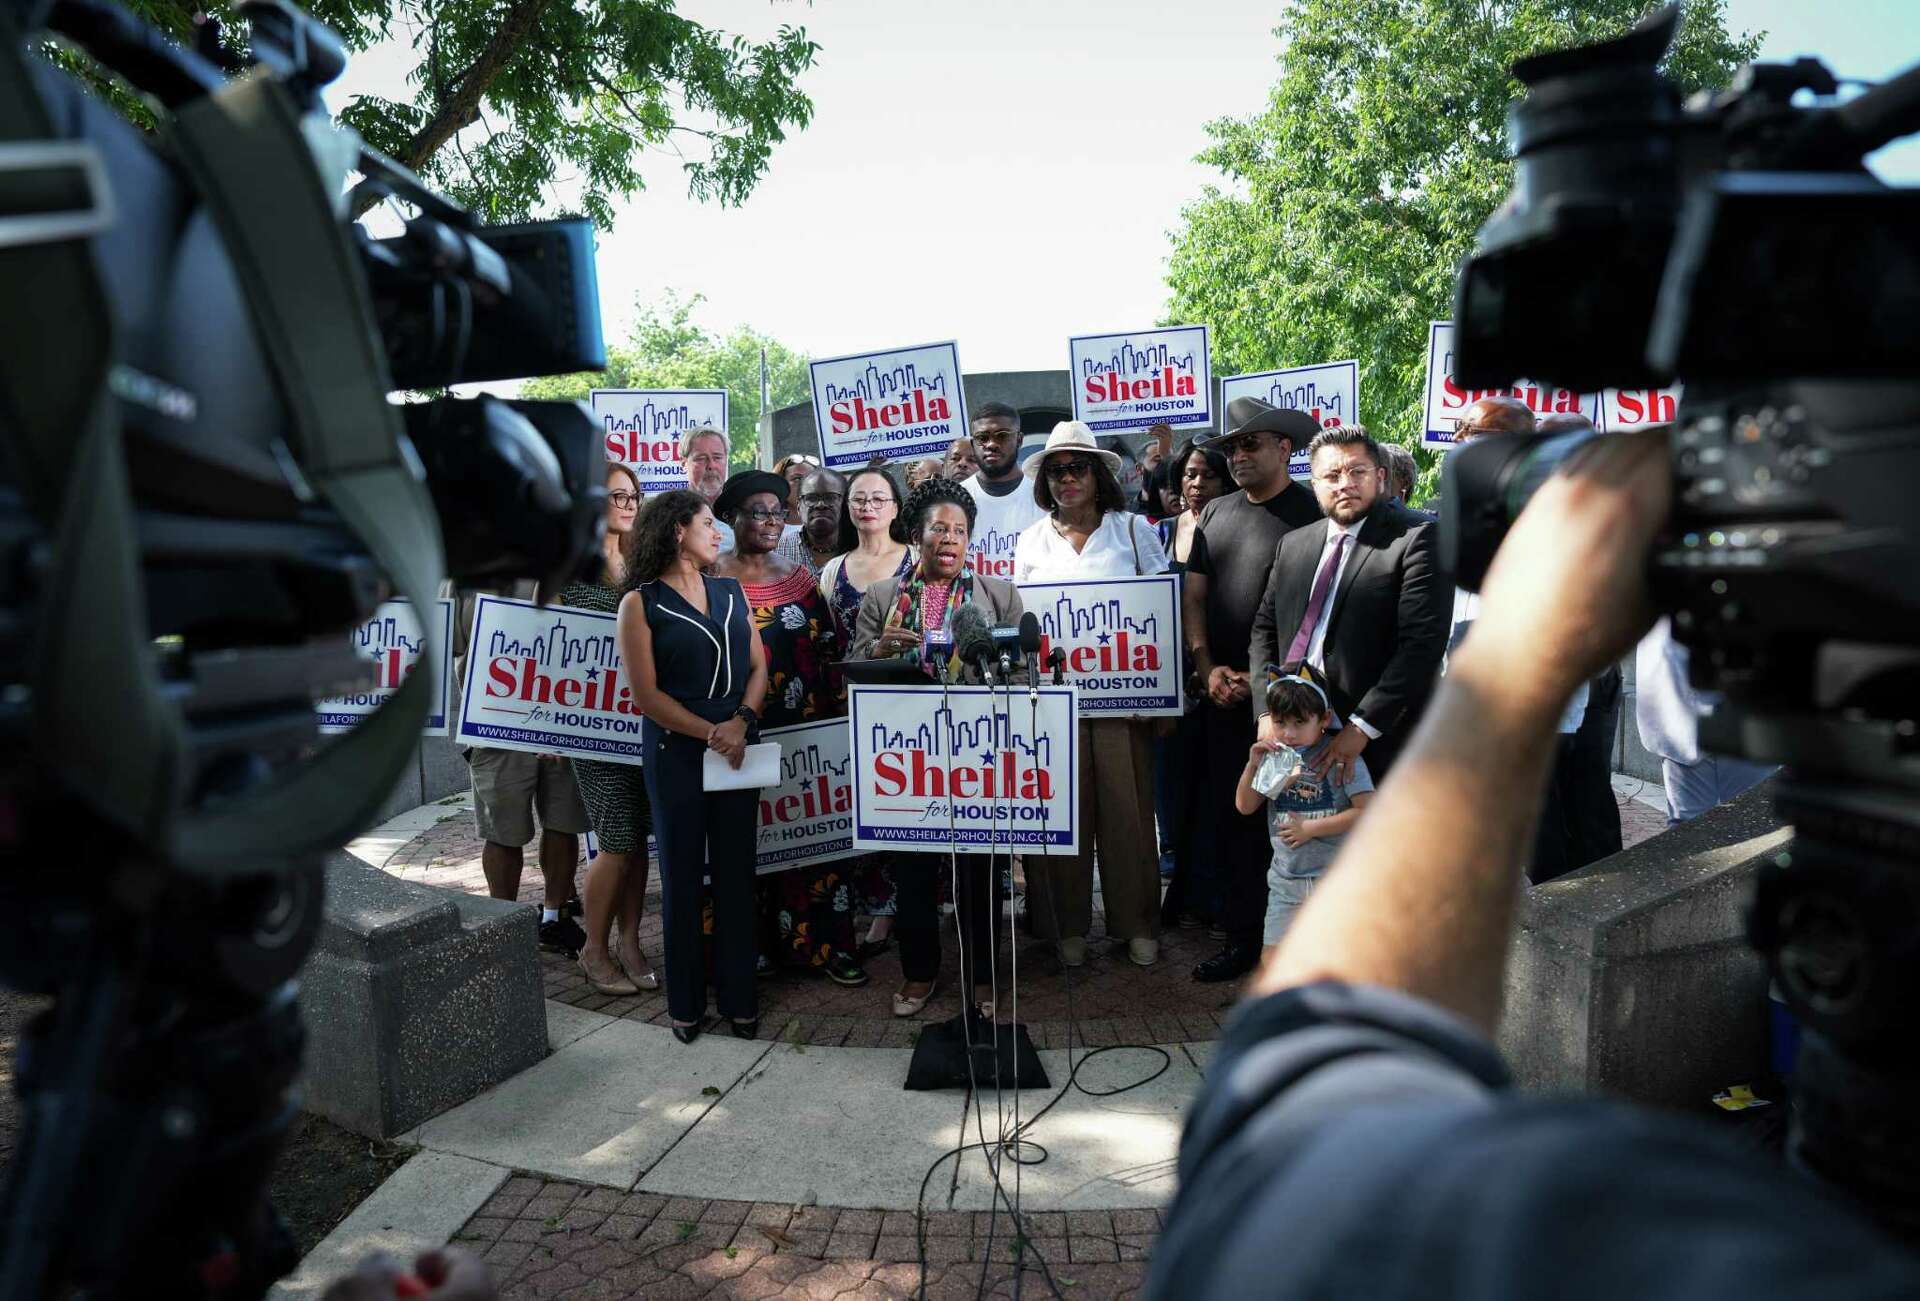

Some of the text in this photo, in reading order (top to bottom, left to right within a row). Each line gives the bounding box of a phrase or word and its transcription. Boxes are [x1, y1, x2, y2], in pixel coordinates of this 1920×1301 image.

[1086, 367, 1197, 403] Sheila
[830, 389, 952, 434] Sheila
[1135, 400, 1194, 412] HOUSTON
[606, 431, 681, 463] Shei
[885, 424, 950, 442] HOUSTON
[1040, 631, 1163, 673] heila
[486, 656, 644, 716] Sheila
[1075, 676, 1158, 690] HOUSTON
[521, 705, 640, 734] for HOUSTON
[477, 725, 644, 754] WWW.SHEILAFORHOUSTON.COM
[874, 749, 1056, 800] Sheila
[918, 800, 1049, 822] for HOUSTON
[873, 828, 1057, 842] WWW.SHEILAFORHOUSTON.COM
